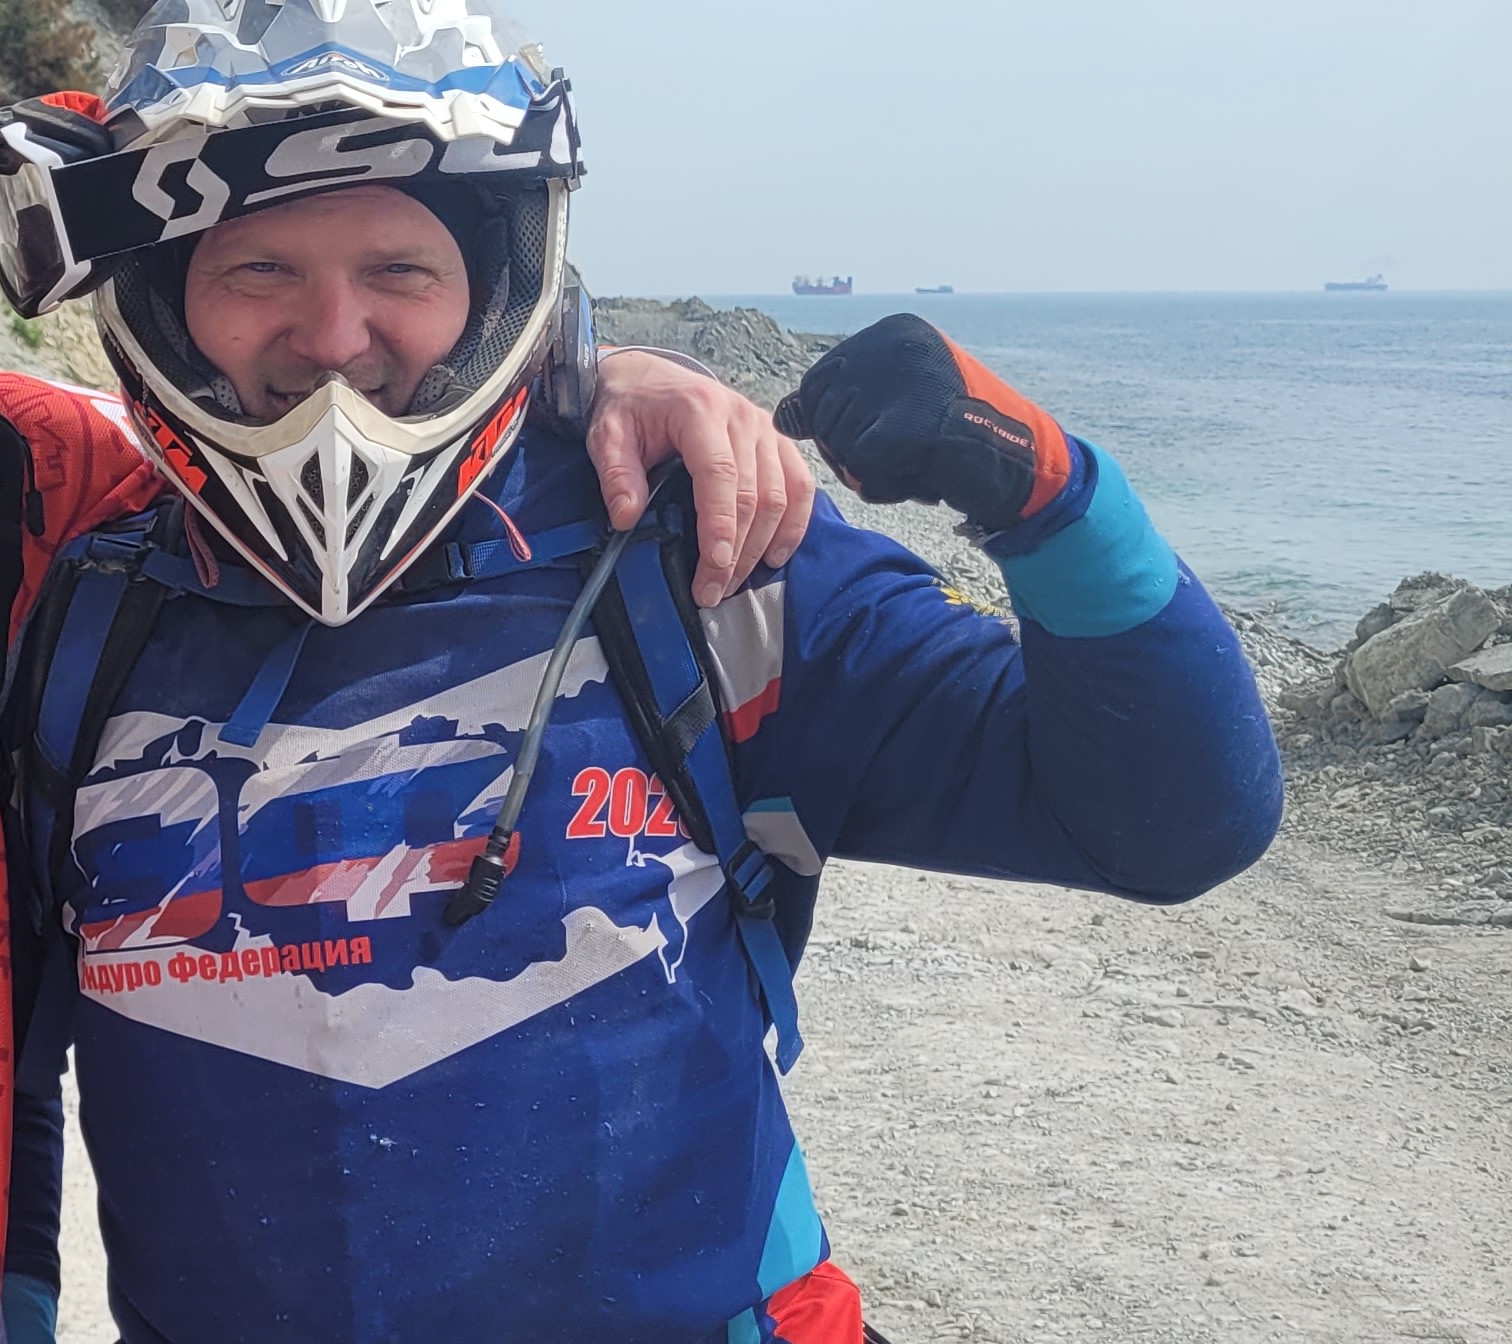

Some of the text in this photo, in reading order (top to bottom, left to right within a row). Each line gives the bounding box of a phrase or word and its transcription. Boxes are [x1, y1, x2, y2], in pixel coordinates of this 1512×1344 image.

[566, 766, 693, 840] 202
[80, 935, 373, 994] ндуро Федерация
